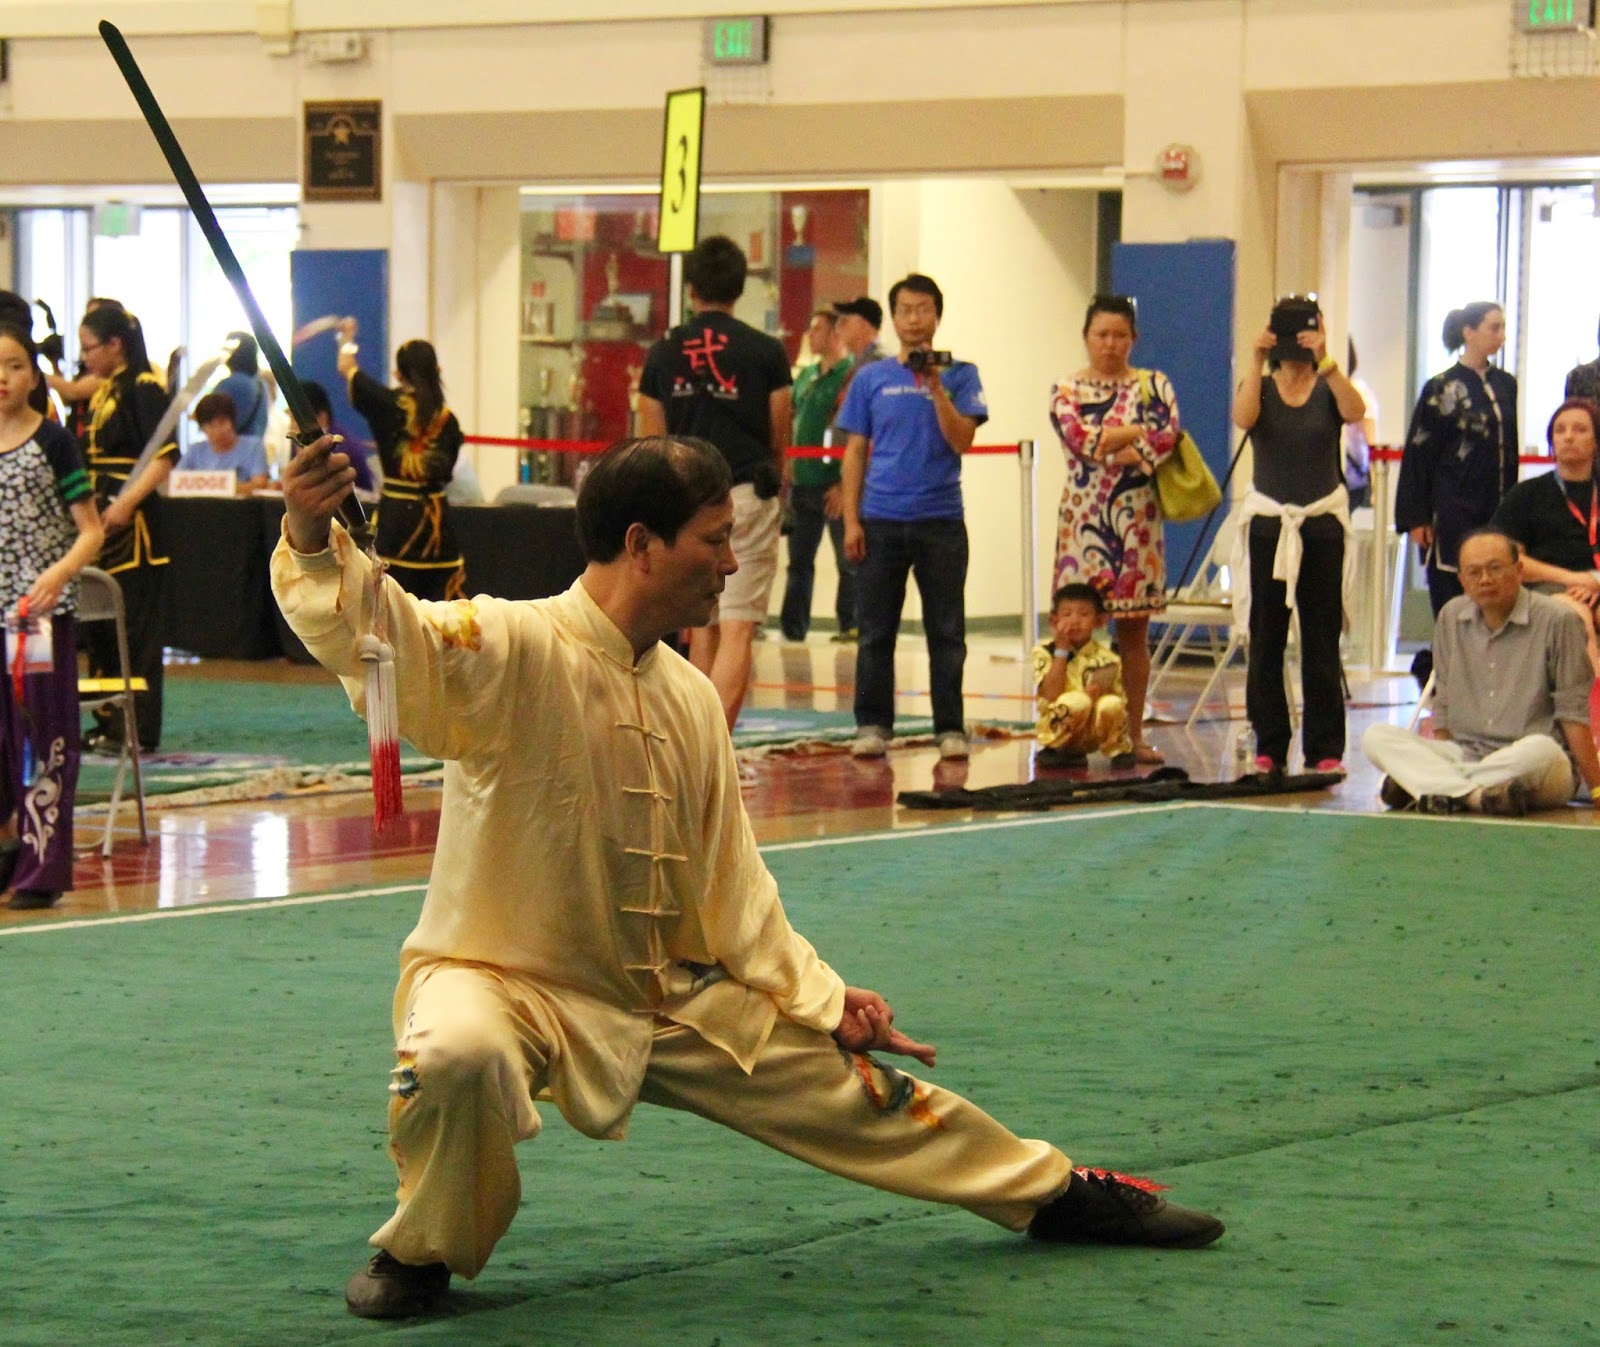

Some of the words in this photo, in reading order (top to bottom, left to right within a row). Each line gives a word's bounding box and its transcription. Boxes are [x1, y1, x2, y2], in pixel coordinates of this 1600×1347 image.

[714, 21, 753, 57] EXIT
[669, 134, 688, 214] 3
[682, 328, 736, 393] 武
[176, 475, 226, 491] JUDGE
